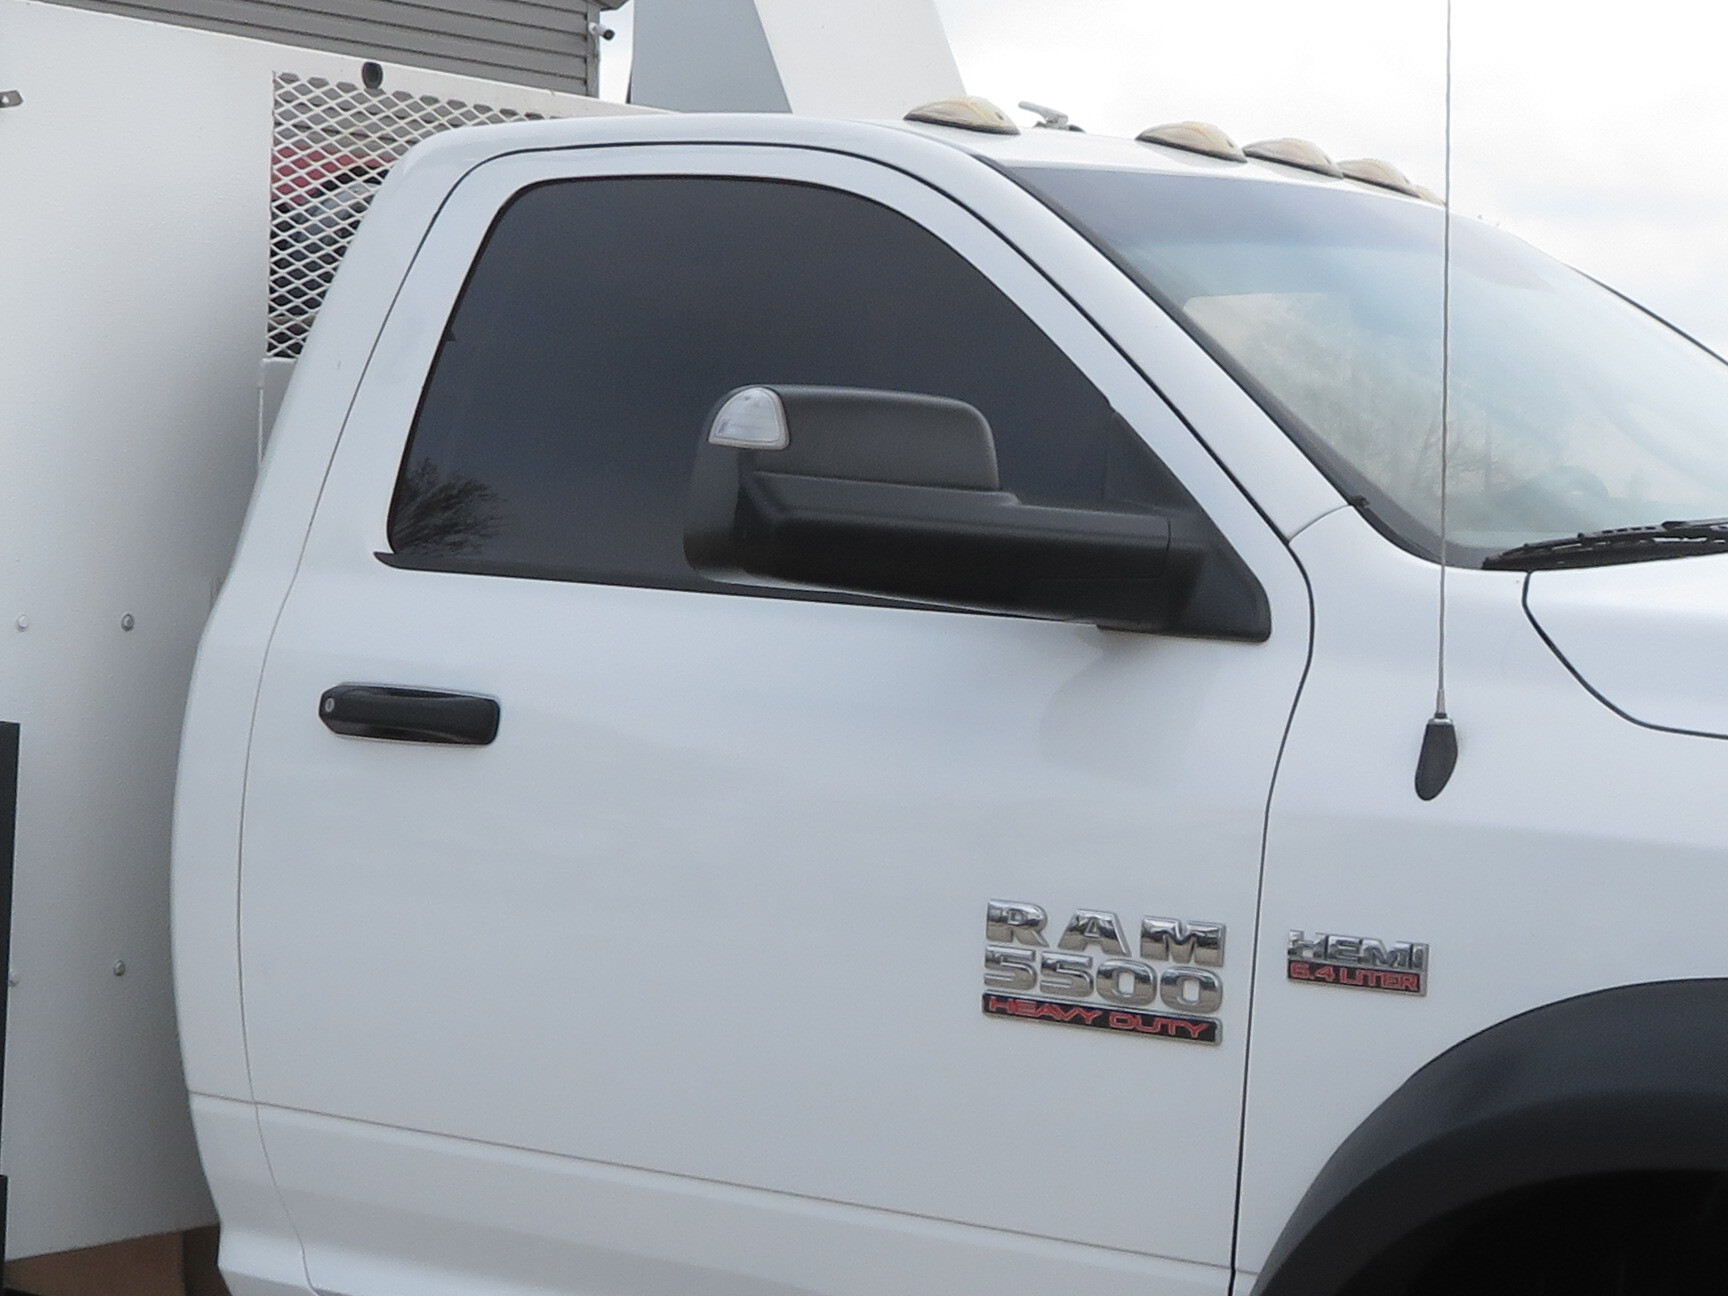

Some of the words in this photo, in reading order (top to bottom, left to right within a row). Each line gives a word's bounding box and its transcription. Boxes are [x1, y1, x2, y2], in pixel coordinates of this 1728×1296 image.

[985, 898, 1226, 967] RAM
[1287, 929, 1429, 971] HEMI
[984, 945, 1223, 1014] 5500
[1290, 961, 1335, 982] 6.4
[1339, 967, 1419, 991] LITER
[989, 997, 1103, 1025] HEAVY
[1108, 1012, 1210, 1039] DUTY
